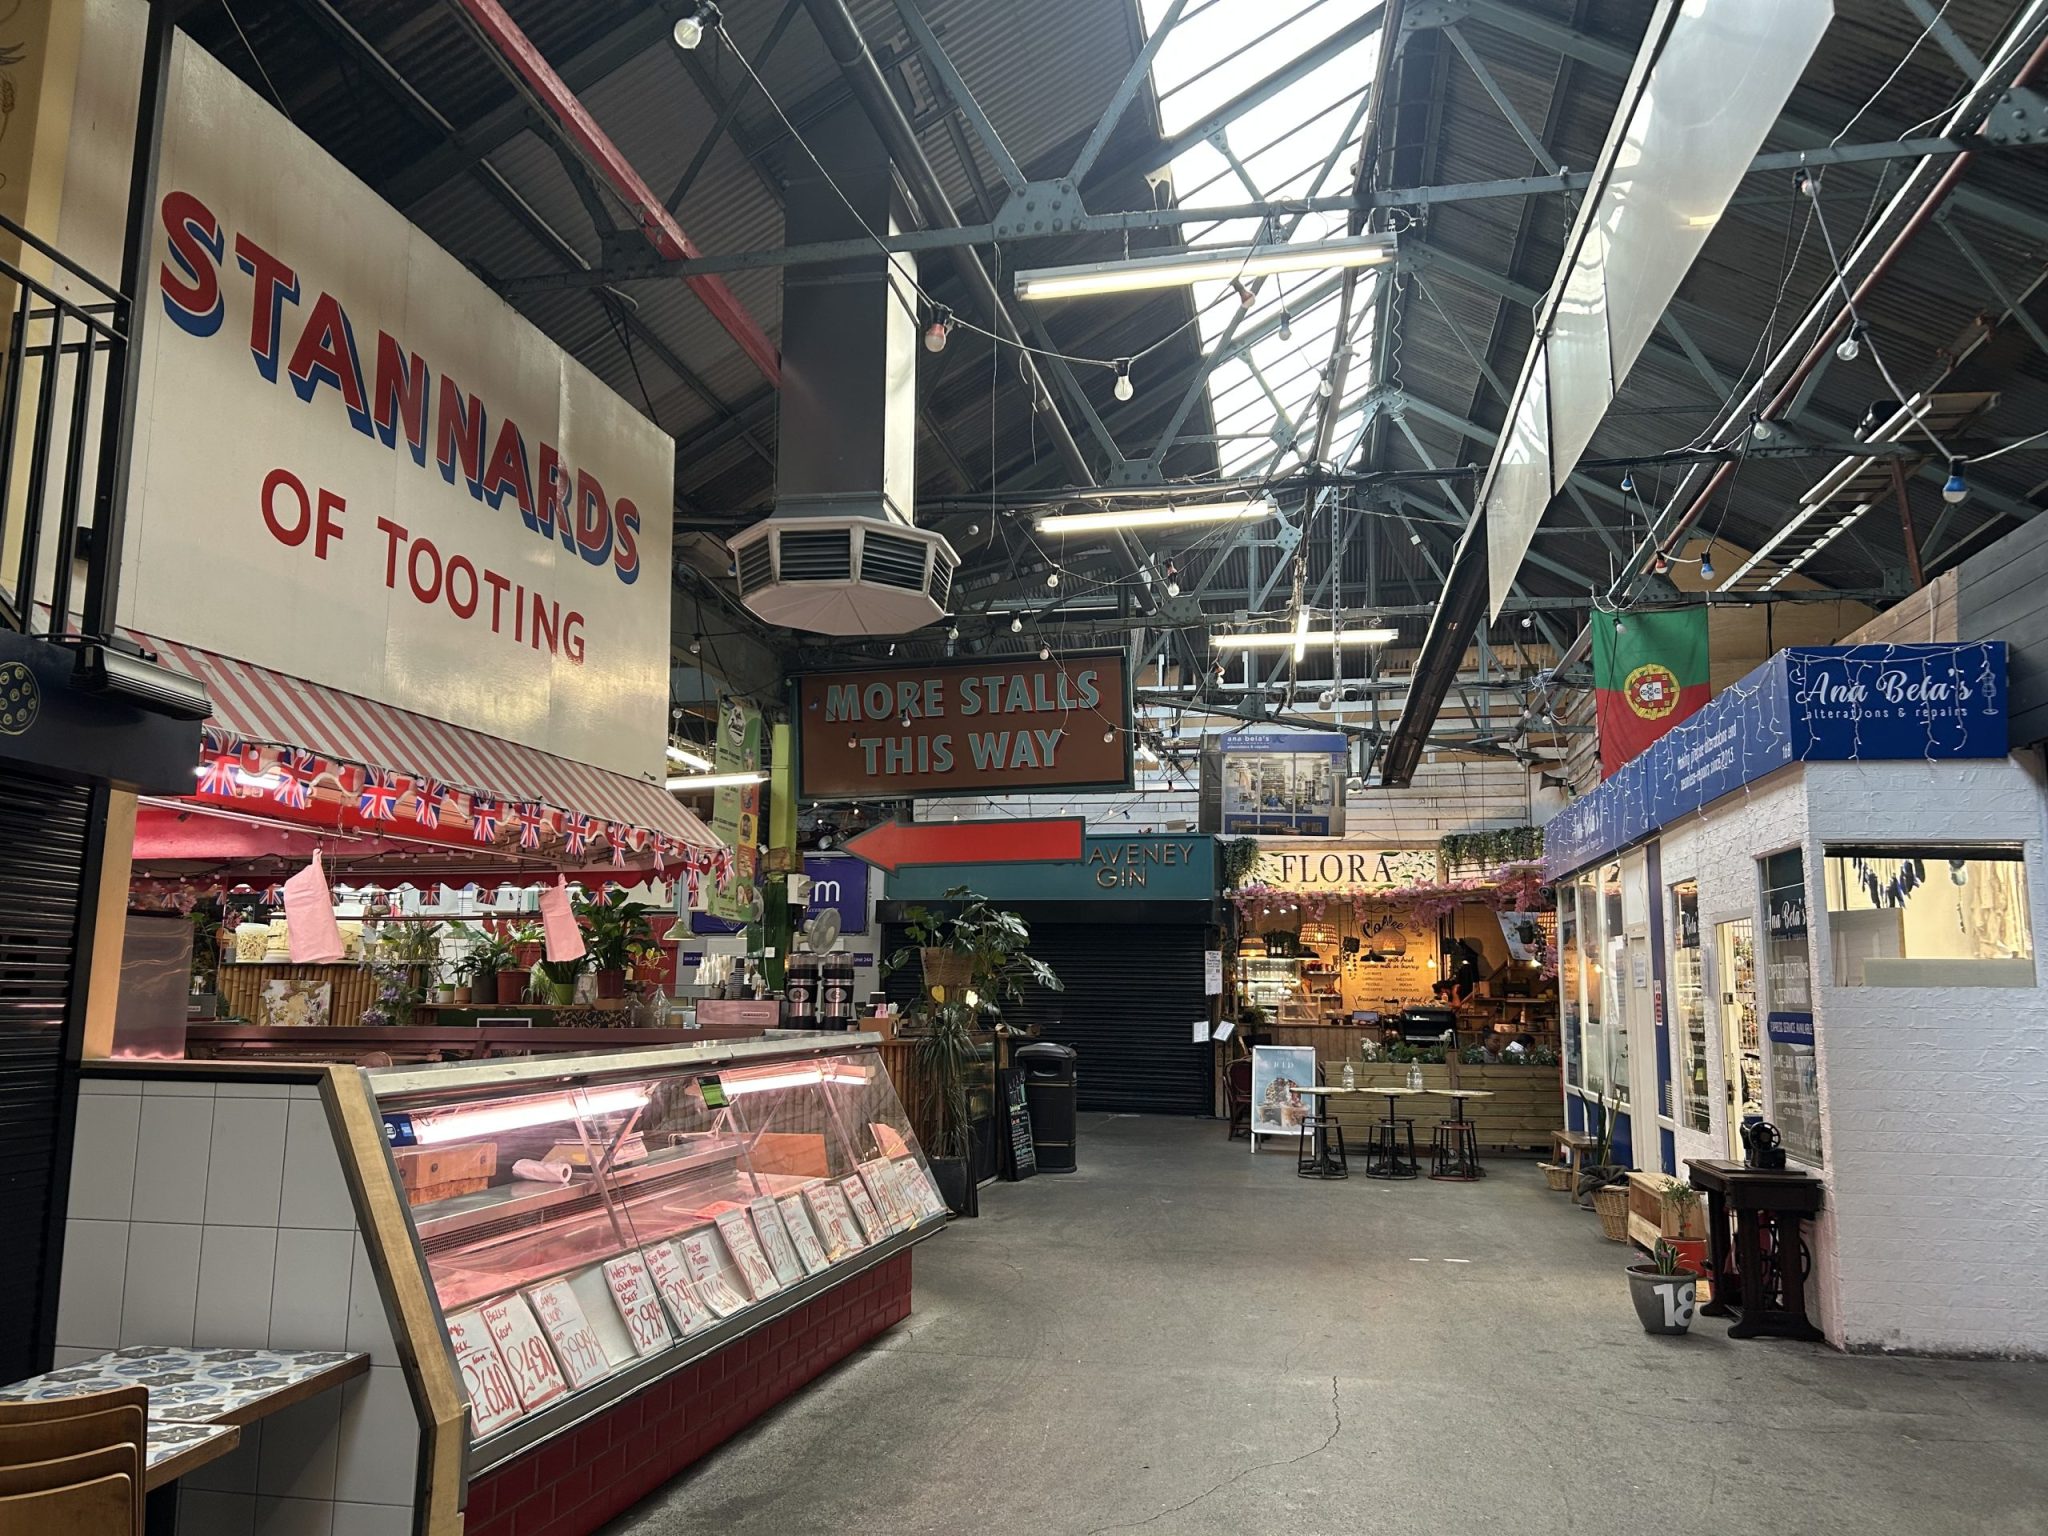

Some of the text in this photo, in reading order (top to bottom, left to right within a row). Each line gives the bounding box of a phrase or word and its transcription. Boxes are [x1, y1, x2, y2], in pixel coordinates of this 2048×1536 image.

[160, 191, 641, 585] STANNARDS
[261, 469, 585, 666] OF TOOTING
[826, 670, 1100, 722] MORE STALLS
[1795, 669, 1973, 705] Ana Bela's
[1898, 708, 1906, 719] &
[1915, 708, 1968, 721] repairs
[860, 729, 1063, 776] THIS WAY
[1088, 843, 1194, 865] AVENEY
[1281, 854, 1393, 883] FLORA
[1096, 866, 1147, 888] GIN
[620, 1290, 638, 1306] BEEF
[1653, 1283, 1695, 1327] 18
[486, 1307, 508, 1324] BELLY
